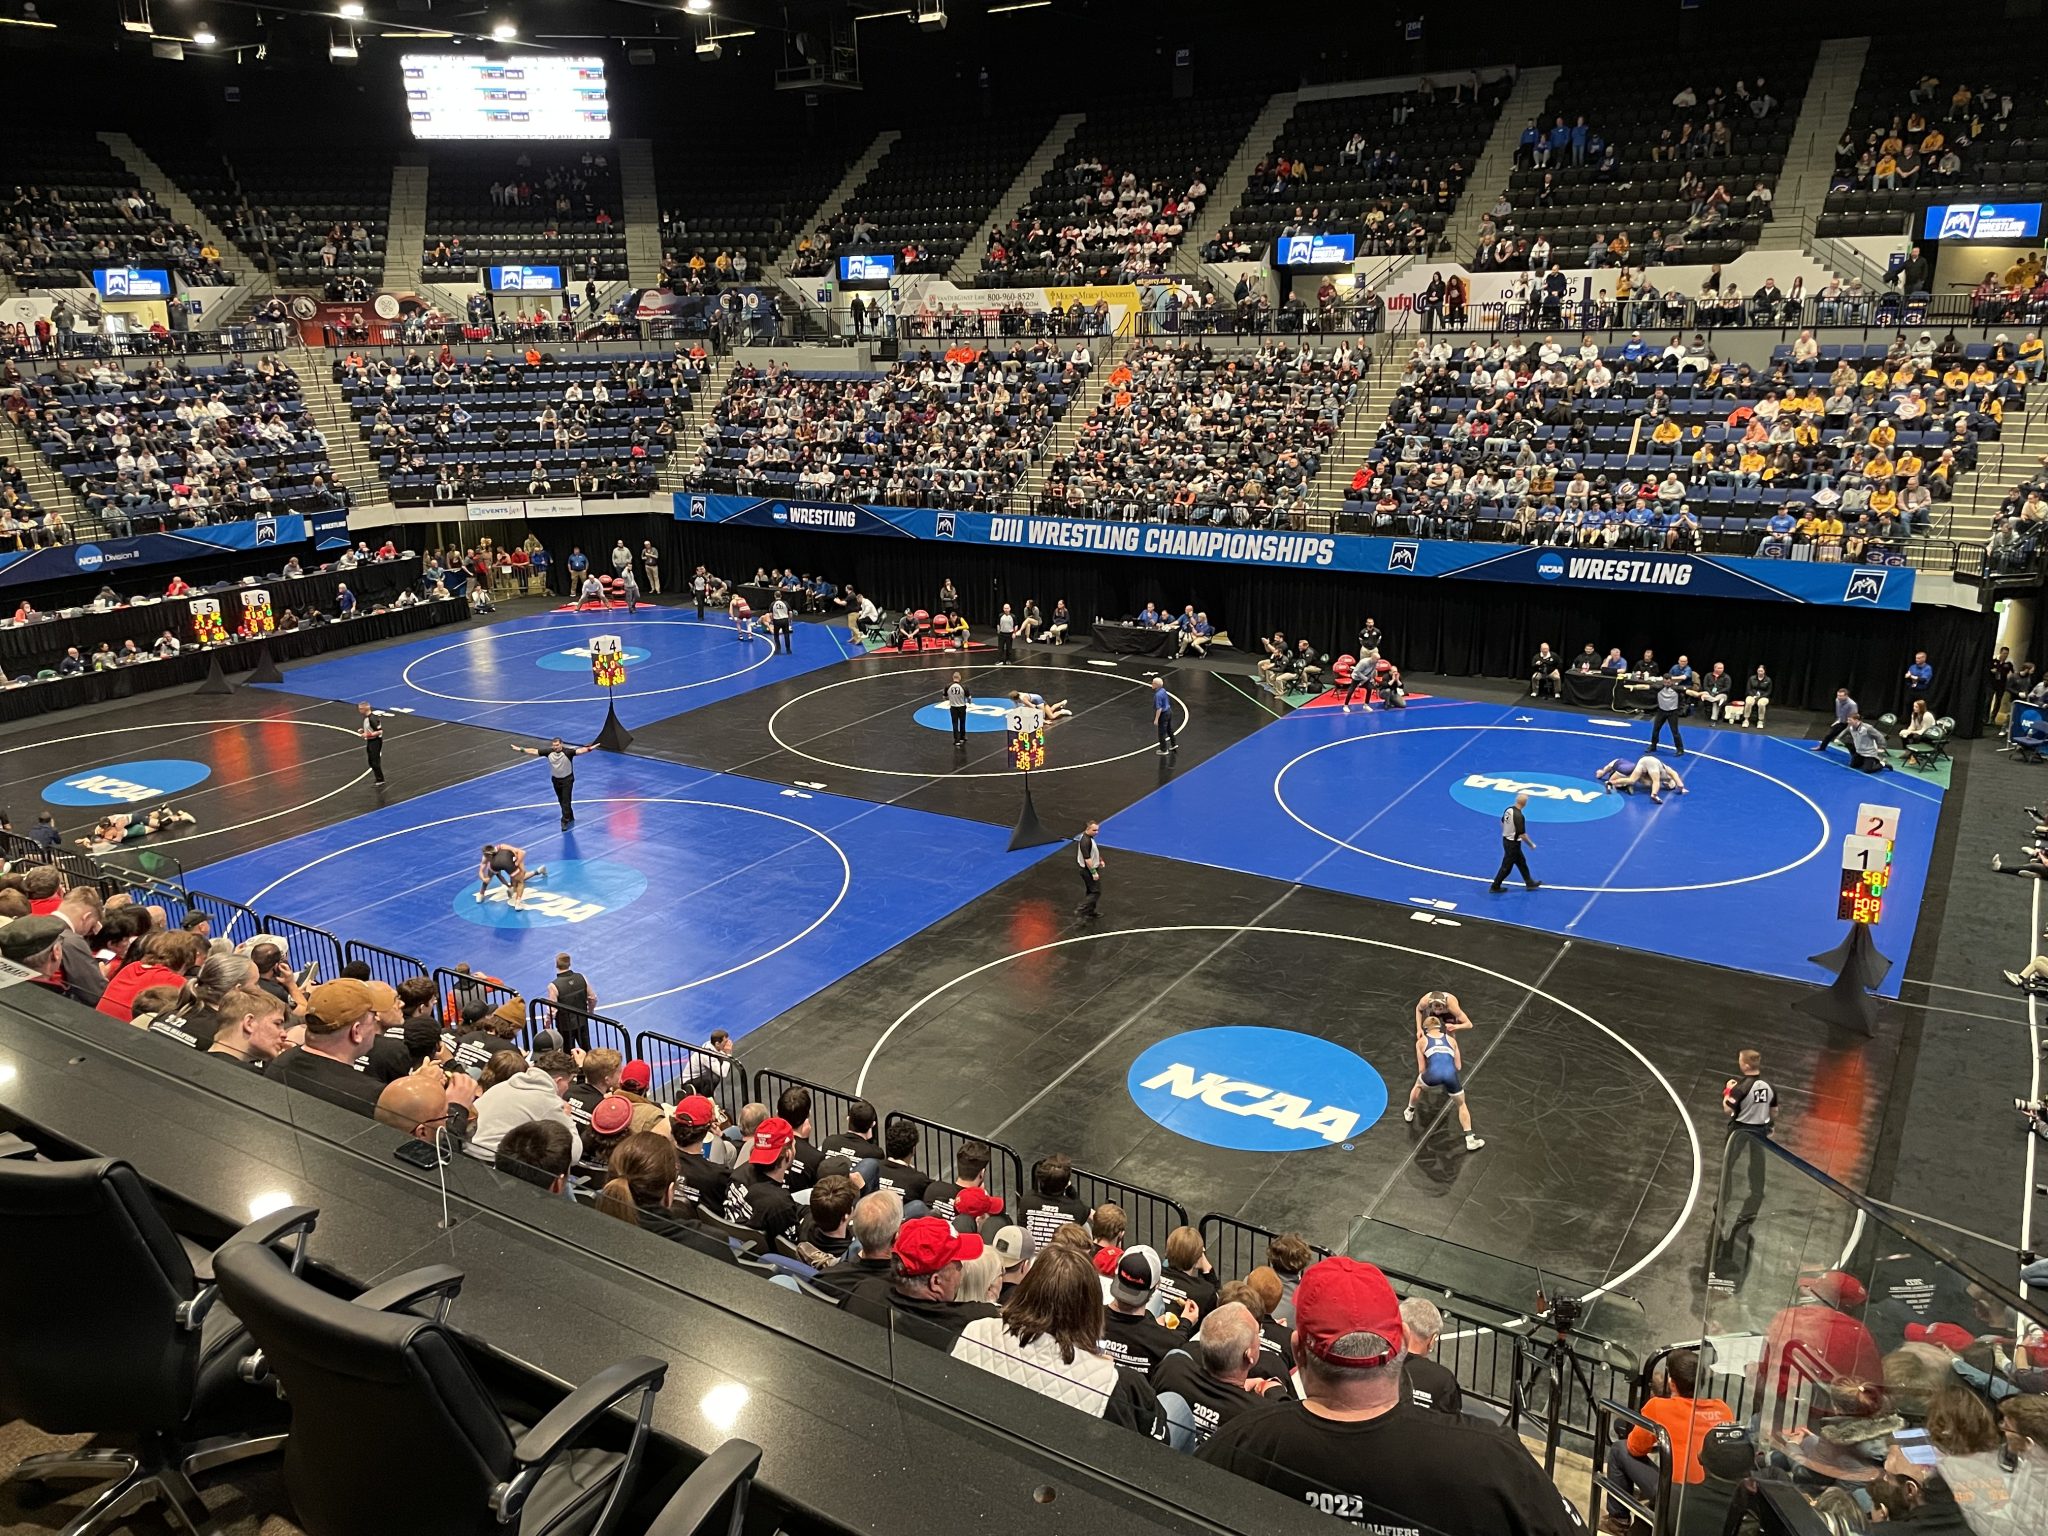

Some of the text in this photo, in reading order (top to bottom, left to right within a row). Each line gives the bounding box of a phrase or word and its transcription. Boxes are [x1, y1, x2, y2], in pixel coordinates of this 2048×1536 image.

[987, 292, 1035, 302] 800-960-8529
[481, 507, 509, 515] EVENTS
[789, 507, 856, 528] WRESTLING
[989, 518, 1336, 565] DIII WRESTLING CHAMPIONSHIPS
[105, 552, 133, 562] Division
[1538, 557, 1693, 586] NCAA WRESTLING
[245, 594, 250, 605] 6
[258, 593, 265, 604] 6
[193, 603, 199, 613] 5
[206, 602, 213, 613] 5
[594, 641, 601, 653] 4
[609, 640, 616, 652] 4
[1013, 715, 1023, 731] 3
[1033, 713, 1040, 729] 3
[1018, 732, 1029, 742] 60
[1024, 741, 1030, 751] 3
[64, 775, 165, 802] NCAA
[1463, 774, 1602, 804] NCAA
[1867, 817, 1884, 837] 2
[1857, 849, 1869, 870] 1
[1862, 871, 1882, 885] 58
[1871, 884, 1881, 897] 0
[472, 885, 607, 923] NCAA
[1139, 1062, 1361, 1144] NCAA
[1042, 1205, 1059, 1213] 2022
[1104, 1340, 1129, 1354] 2022
[1193, 1402, 1221, 1424] 2022
[1305, 1491, 1364, 1518] 2022
